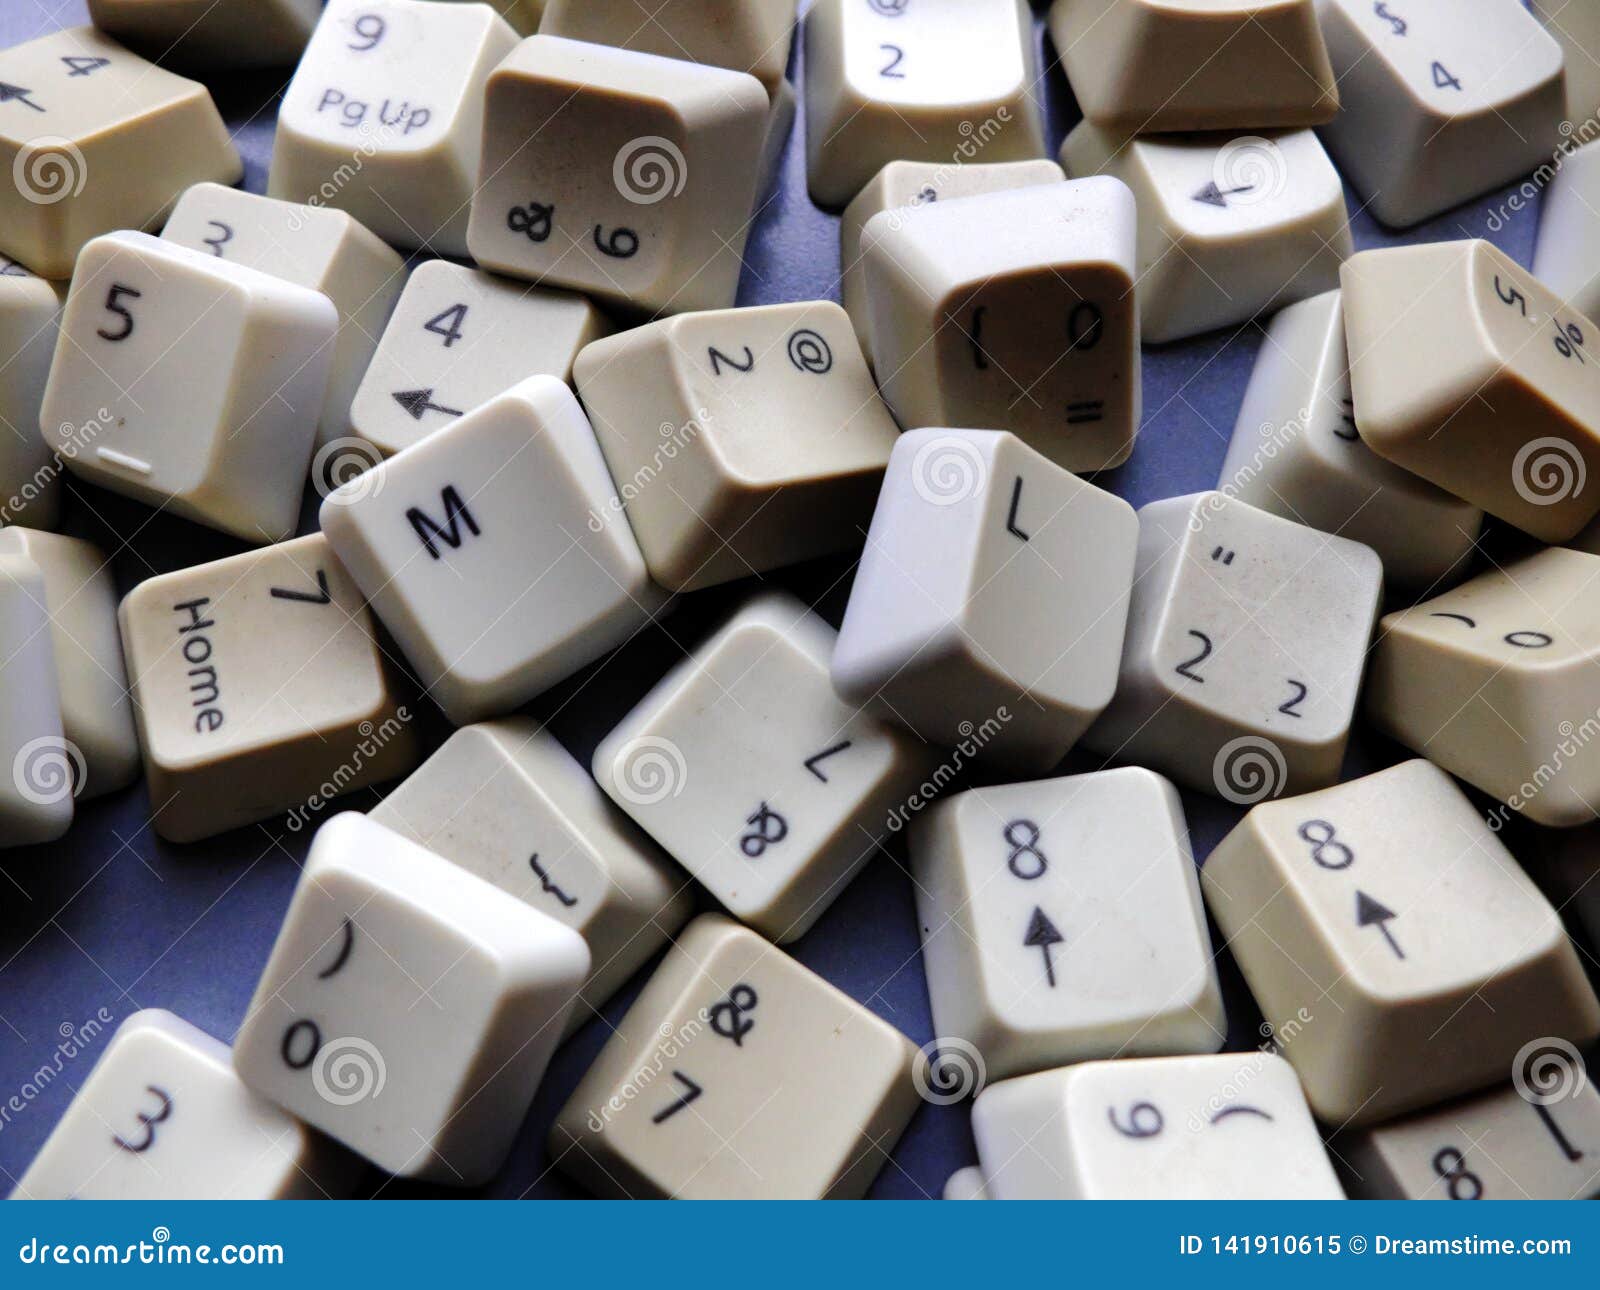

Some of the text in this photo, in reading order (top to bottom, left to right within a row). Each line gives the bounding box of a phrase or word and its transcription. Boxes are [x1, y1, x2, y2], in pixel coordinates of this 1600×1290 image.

[346, 14, 386, 52] 9
[61, 57, 111, 77] 4
[879, 44, 905, 78] 2
[1431, 61, 1461, 91] 4
[316, 88, 431, 135] Pg Up
[507, 202, 554, 242] &
[97, 284, 141, 342] 5
[1494, 275, 1526, 316] 5
[424, 304, 468, 347] 4
[1552, 317, 1584, 364] %
[708, 347, 754, 375] 2
[787, 329, 832, 374] @
[406, 485, 480, 560] M
[1007, 476, 1029, 542] L
[270, 570, 331, 605] 7
[173, 597, 223, 733] Home
[1175, 630, 1212, 683] 2
[740, 802, 788, 858] &
[1003, 820, 1048, 880] 8
[1298, 820, 1354, 870] 8
[319, 916, 355, 979] )
[709, 984, 758, 1047] &
[281, 1019, 322, 1070] 0
[113, 1086, 172, 1154] 3
[653, 1071, 702, 1124] 7
[1432, 1147, 1483, 1200] 8
